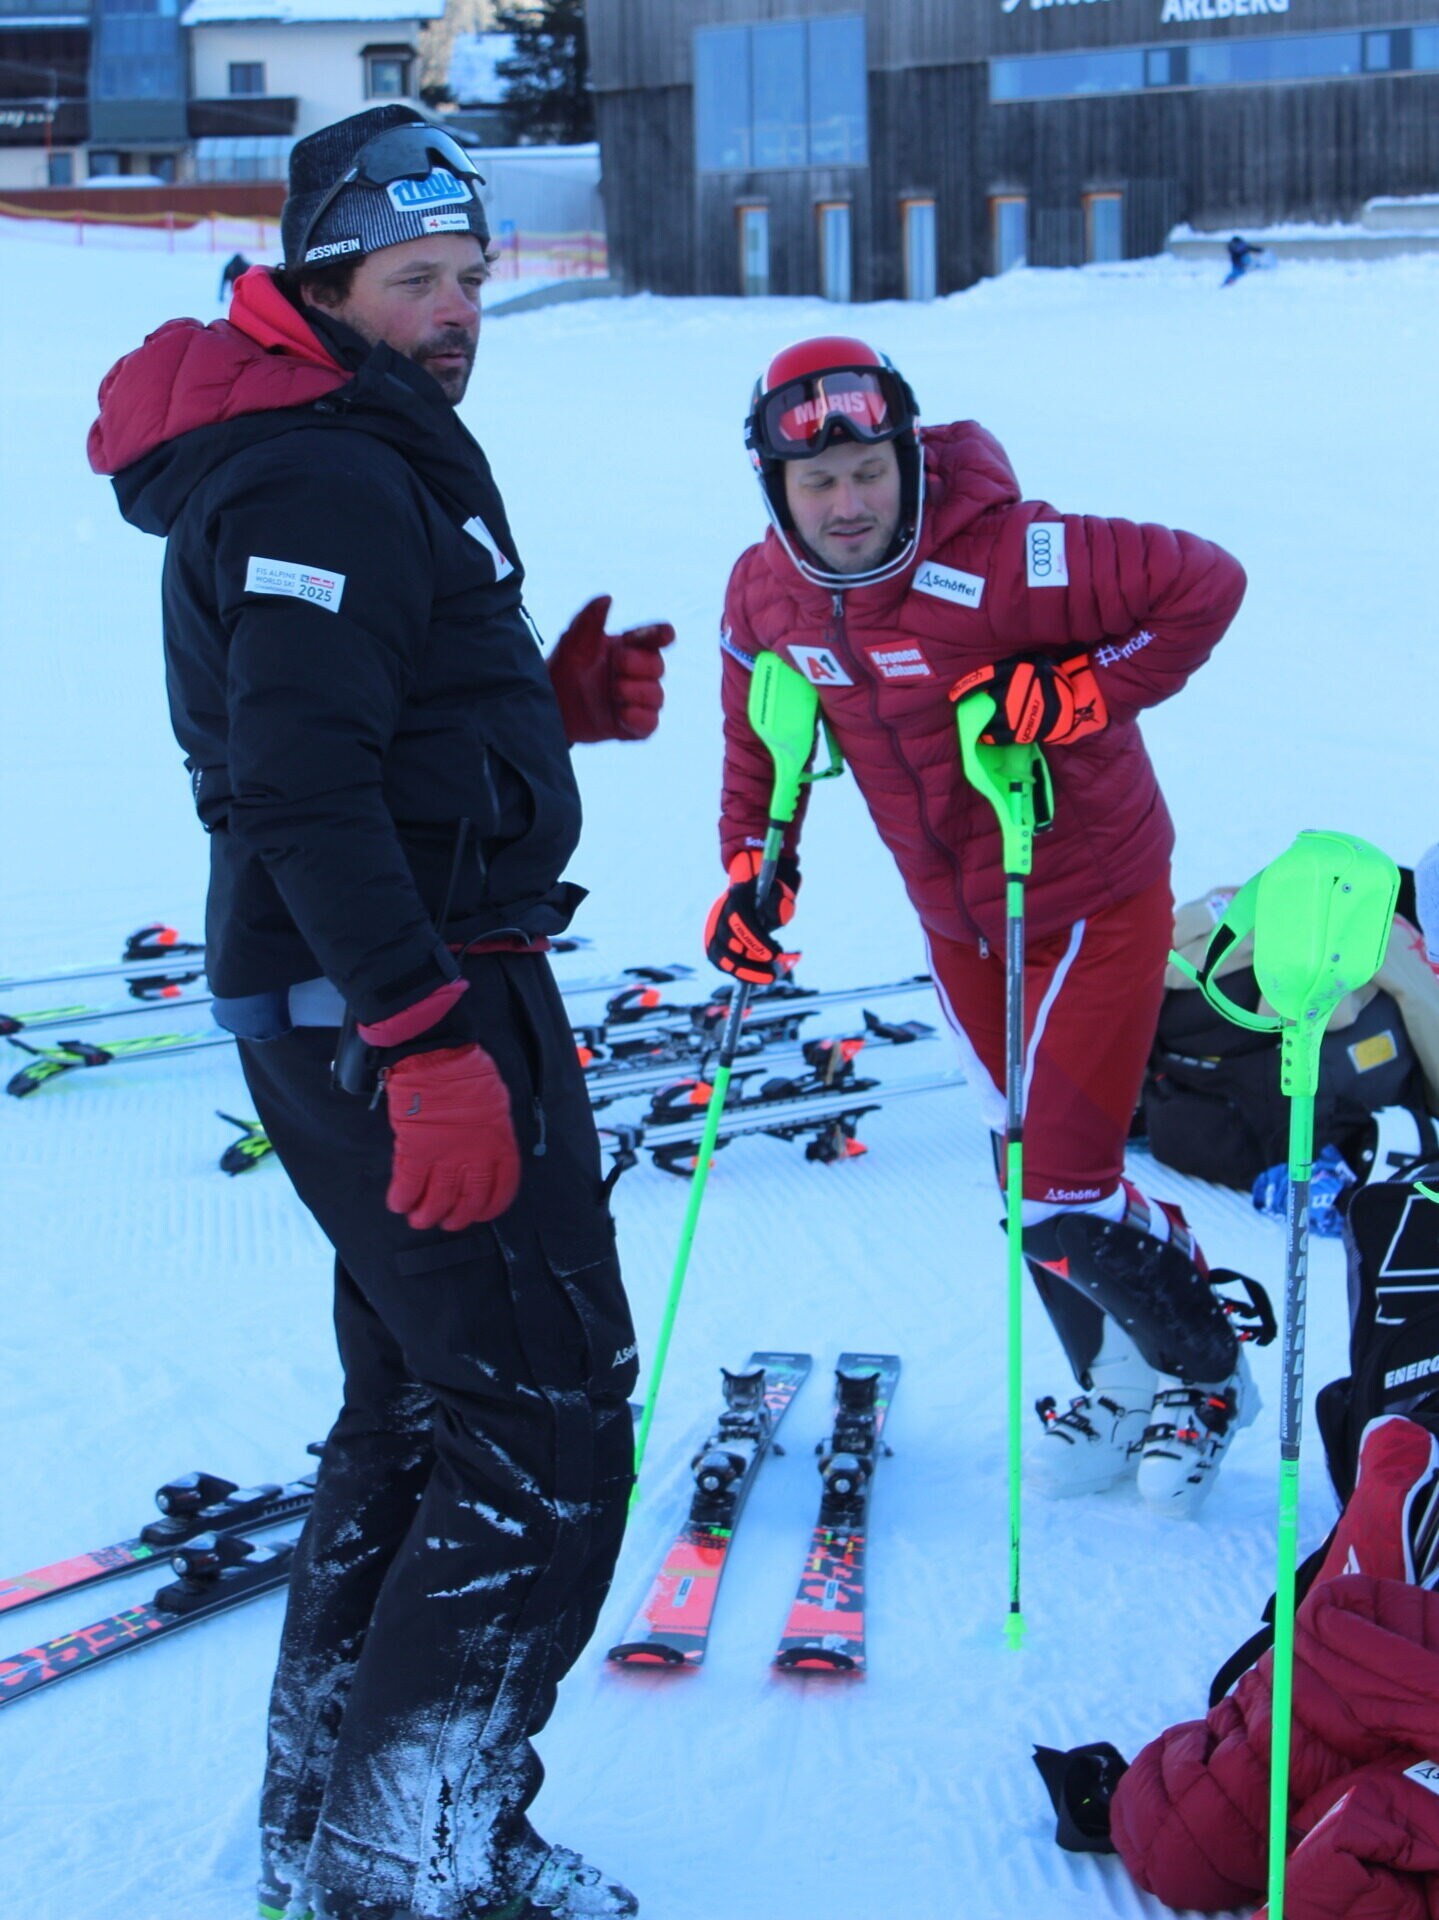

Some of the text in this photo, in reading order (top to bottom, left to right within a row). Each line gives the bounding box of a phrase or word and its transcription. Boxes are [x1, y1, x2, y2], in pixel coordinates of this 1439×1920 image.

[1161, 0, 1289, 23] ARLBERG
[299, 584, 332, 603] 2025
[933, 575, 977, 597] Schöffel
[806, 654, 839, 681] A1
[870, 649, 923, 665] Kronen
[879, 662, 931, 678] Zeitung
[1021, 699, 1041, 743] reusch
